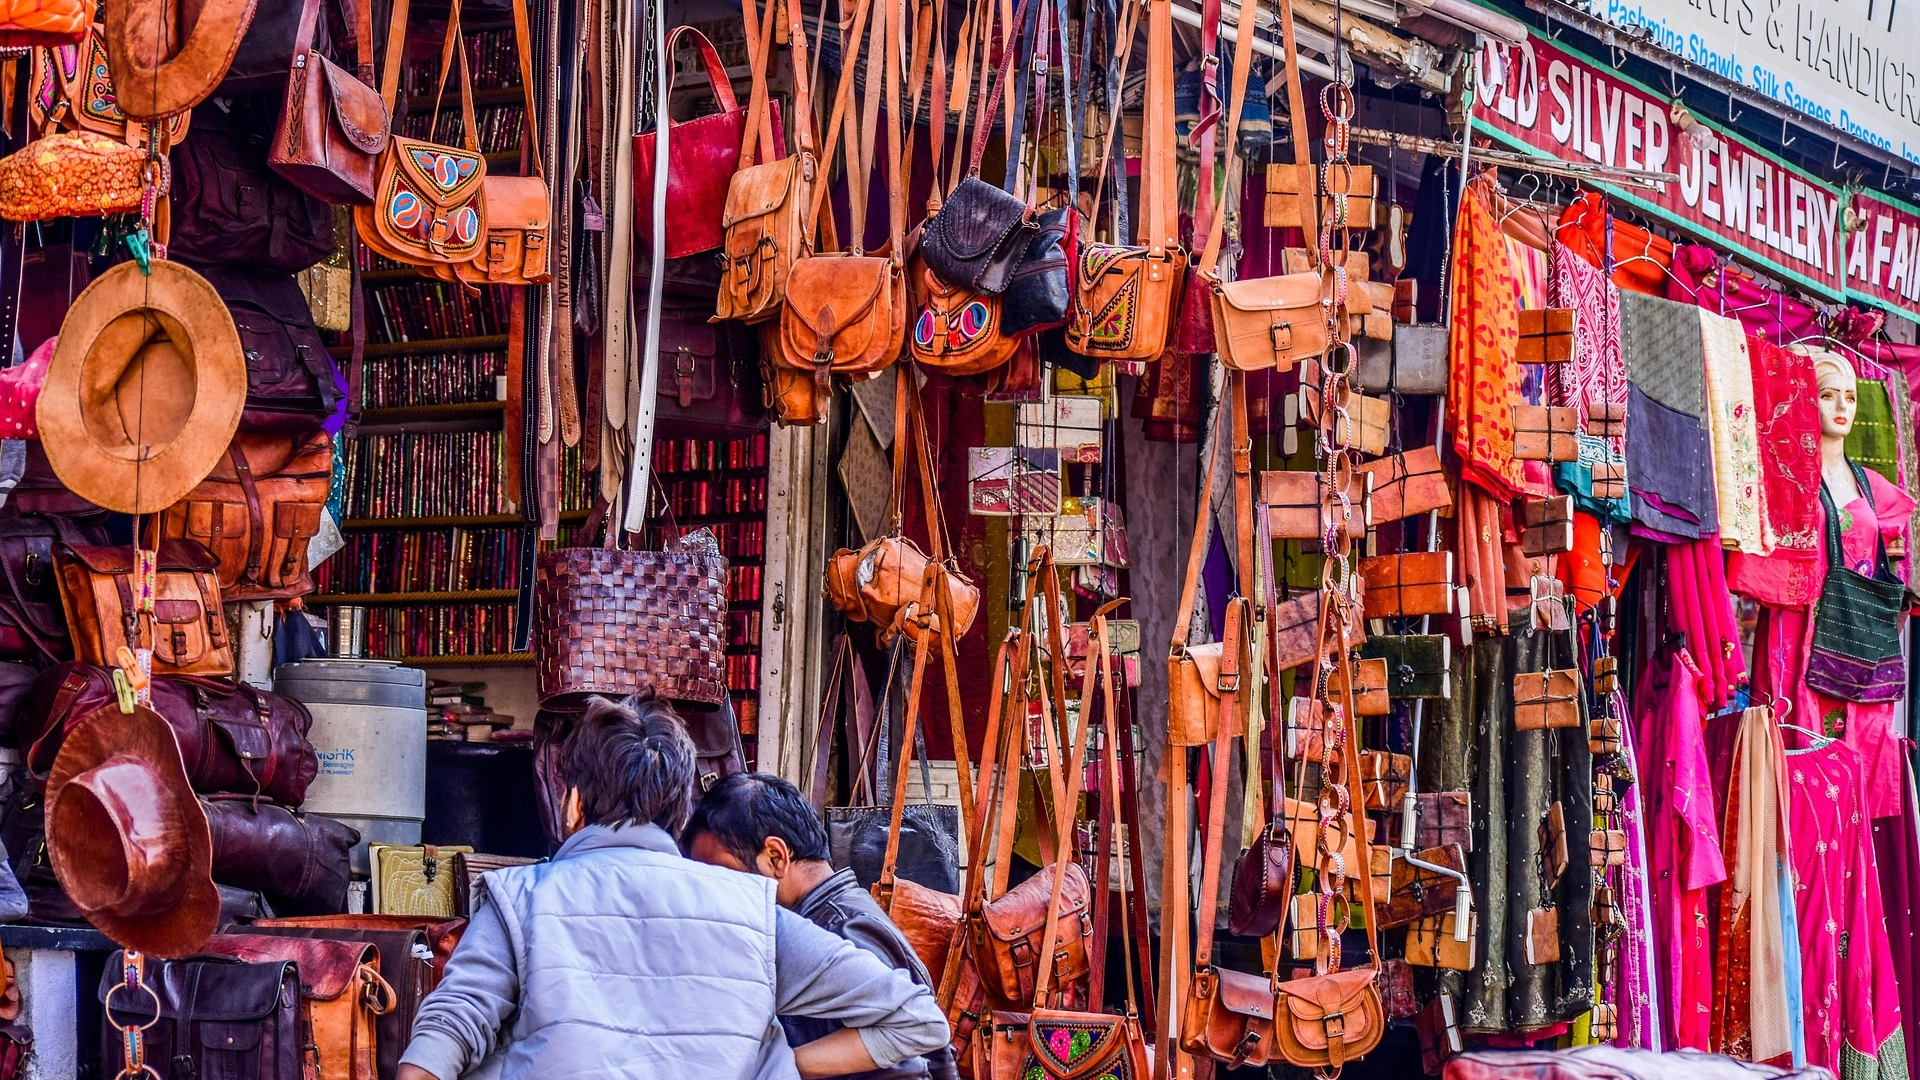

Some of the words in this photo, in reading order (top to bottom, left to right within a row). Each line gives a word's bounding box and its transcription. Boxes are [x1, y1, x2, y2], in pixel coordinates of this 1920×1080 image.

[1753, 65, 1779, 100] Silk
[1475, 36, 1539, 129] OLD
[1548, 59, 1670, 194] SILVER
[1680, 135, 1839, 277] JEWELLERY
[558, 243, 569, 308] ARMANI
[1848, 207, 1867, 283] A
